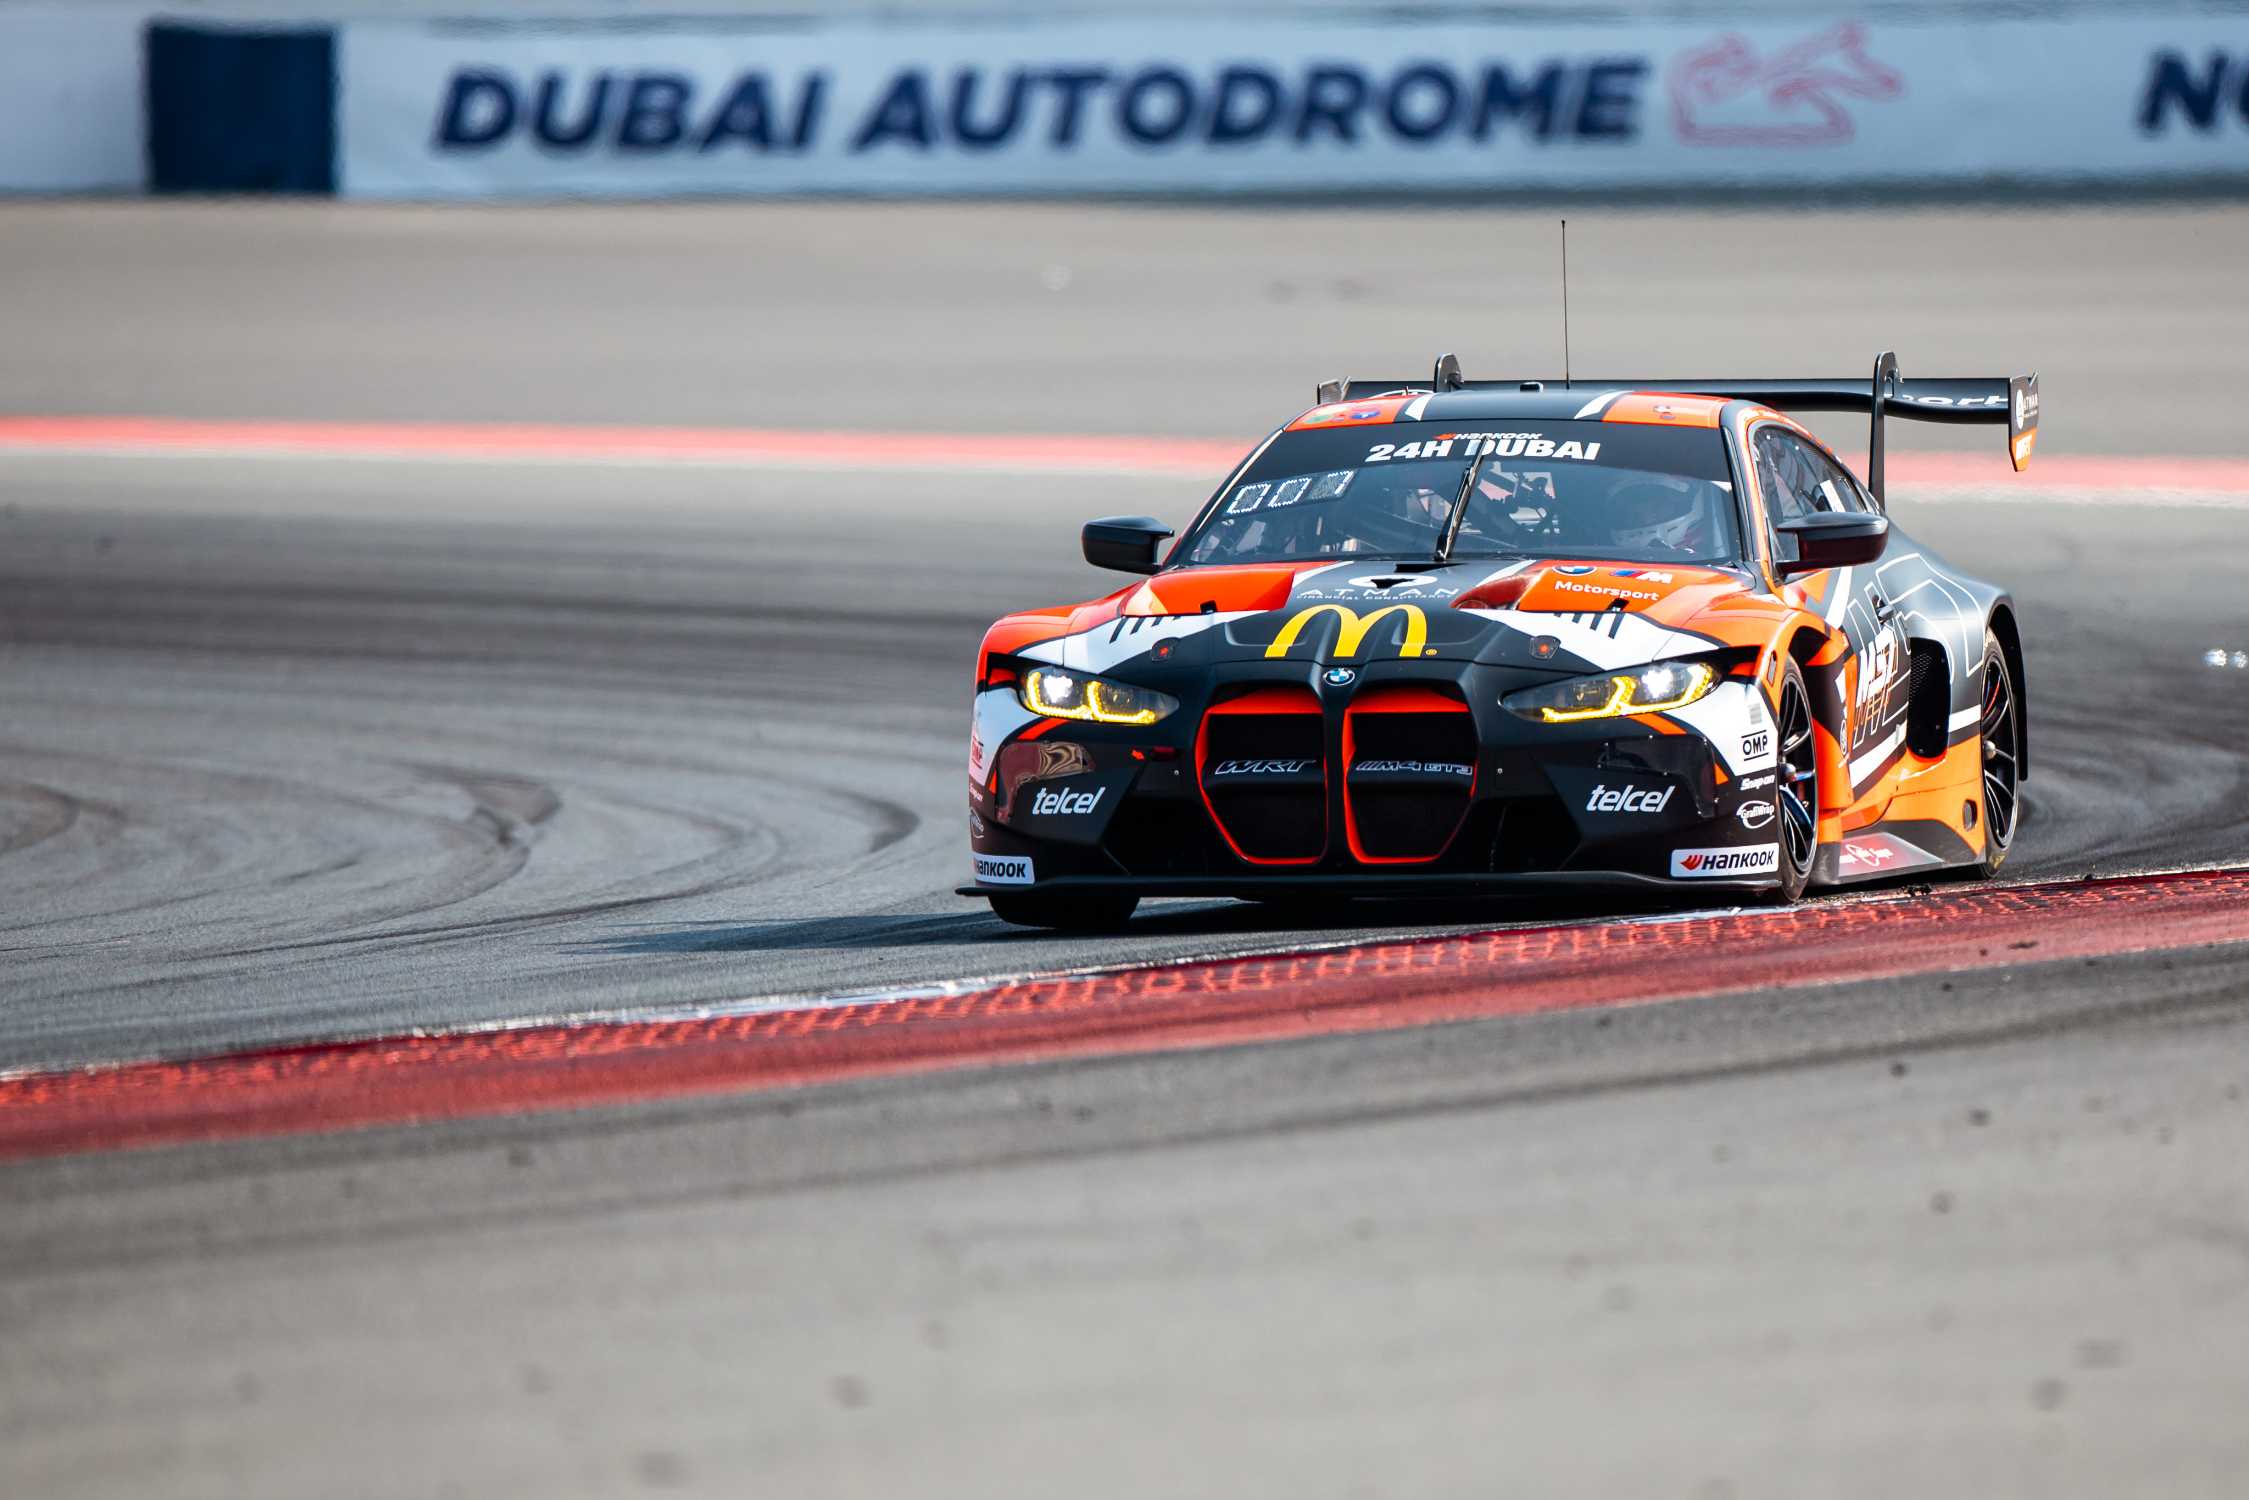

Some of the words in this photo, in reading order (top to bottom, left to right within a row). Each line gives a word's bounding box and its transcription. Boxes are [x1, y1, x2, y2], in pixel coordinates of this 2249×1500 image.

[2135, 51, 2249, 136] N
[436, 69, 830, 155] DUBAI
[852, 57, 1648, 153] AUTODROME
[1365, 440, 1453, 462] 24H
[1464, 440, 1600, 460] DUBAI
[1299, 588, 1460, 597] ATMAN
[1554, 580, 1660, 600] Motorsport
[1742, 734, 1768, 756] OMP
[1214, 760, 1317, 775] WRT
[1032, 786, 1106, 815] telcel
[1586, 784, 1676, 813] telcel
